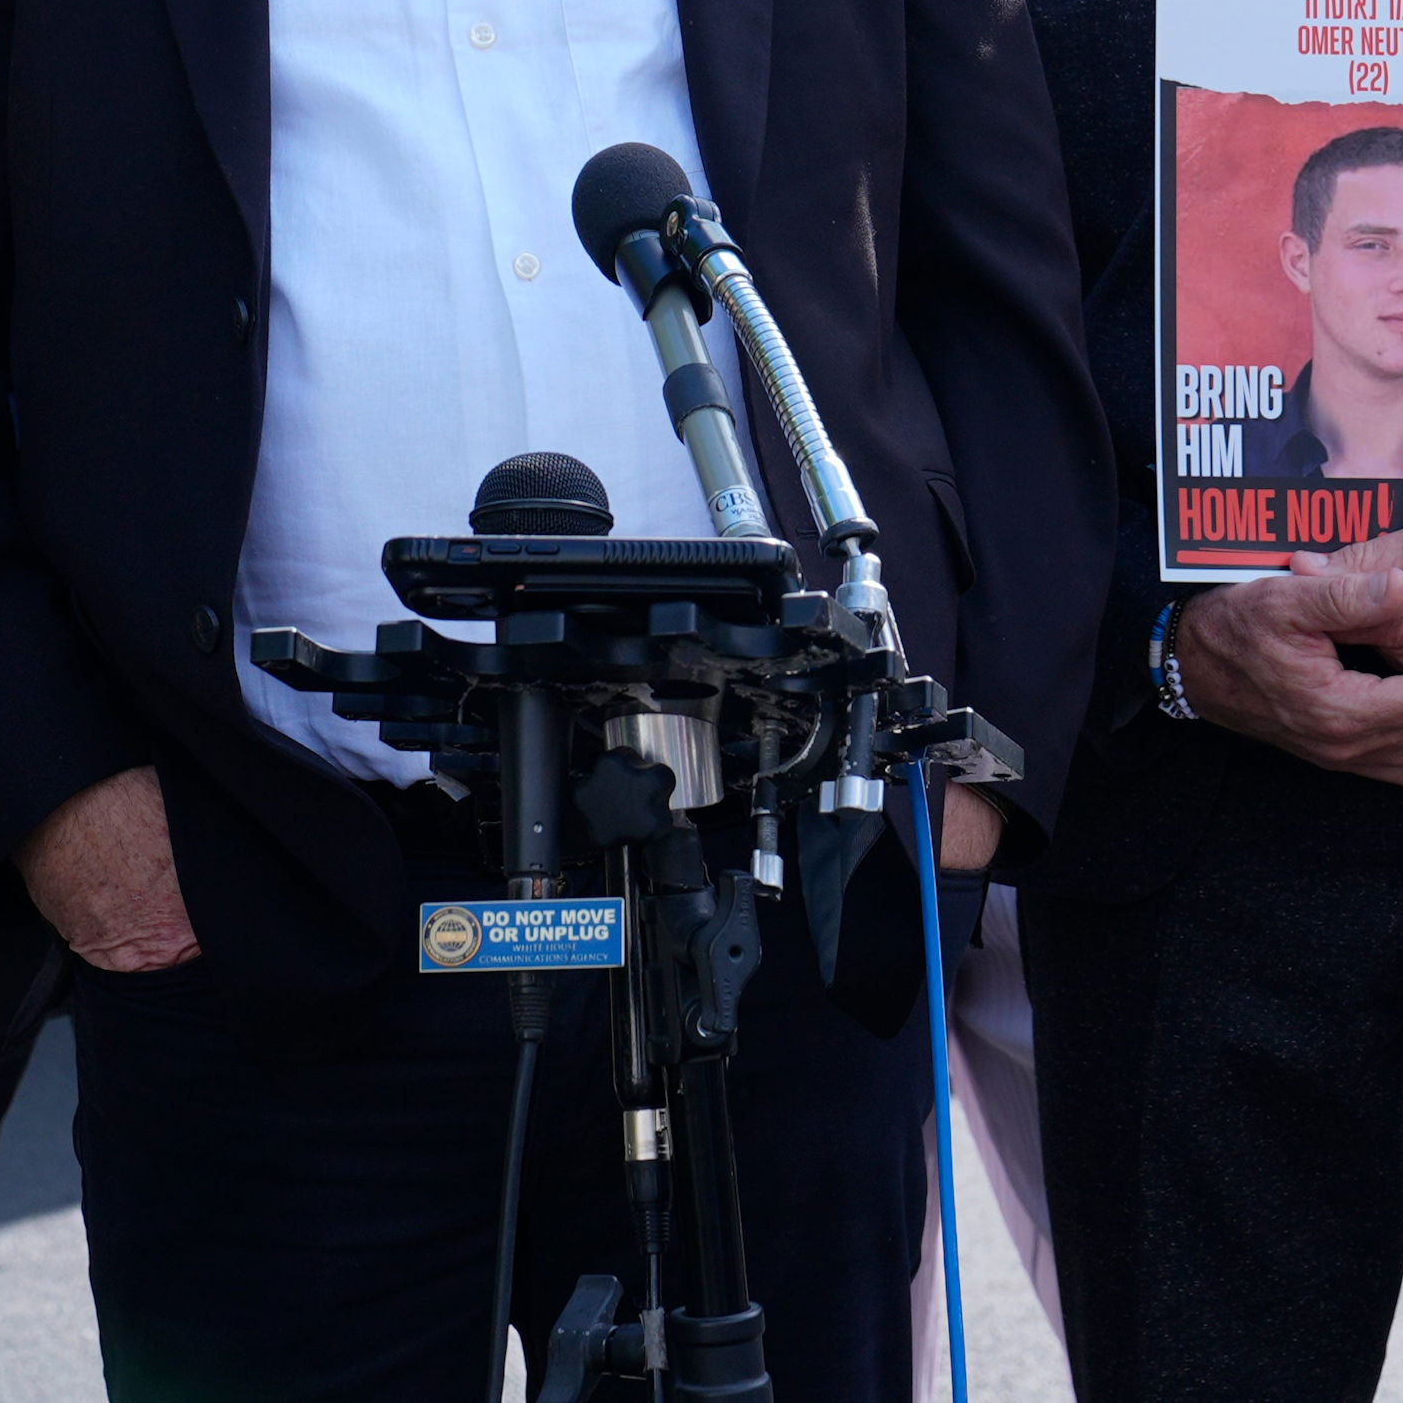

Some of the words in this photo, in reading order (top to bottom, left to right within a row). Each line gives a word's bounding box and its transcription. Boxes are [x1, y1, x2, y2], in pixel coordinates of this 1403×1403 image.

[1298, 25, 1354, 55] OMER
[1349, 60, 1389, 95] (22)
[1176, 364, 1284, 419] BRING
[1177, 424, 1244, 478] HIM
[715, 492, 754, 512] CBS
[1178, 487, 1276, 541] HOME
[482, 911, 510, 926] DO
[515, 910, 555, 926] NOT
[561, 908, 616, 925] MOVE
[489, 927, 519, 943] OR
[525, 925, 609, 942] UNPLUG
